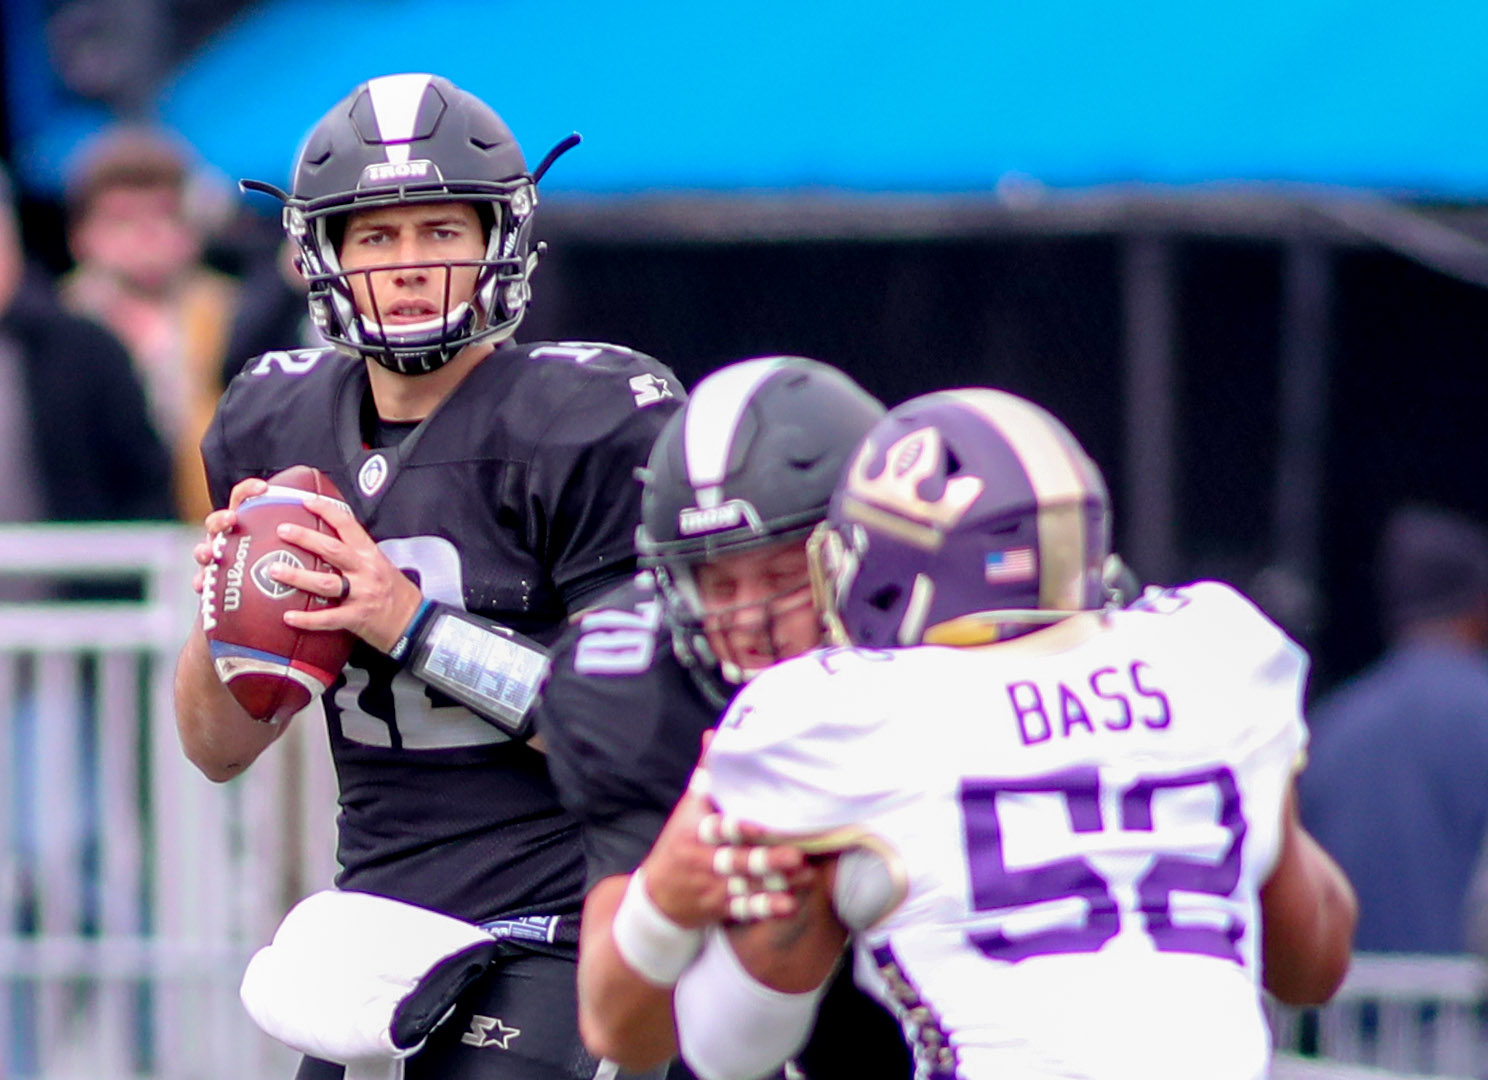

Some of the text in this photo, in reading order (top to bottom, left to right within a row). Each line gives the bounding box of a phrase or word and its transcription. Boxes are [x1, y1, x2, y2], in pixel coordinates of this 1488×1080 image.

[368, 163, 428, 181] IRON
[223, 534, 252, 612] Wilson
[1005, 660, 1172, 747] BASS
[957, 762, 1248, 967] 52
